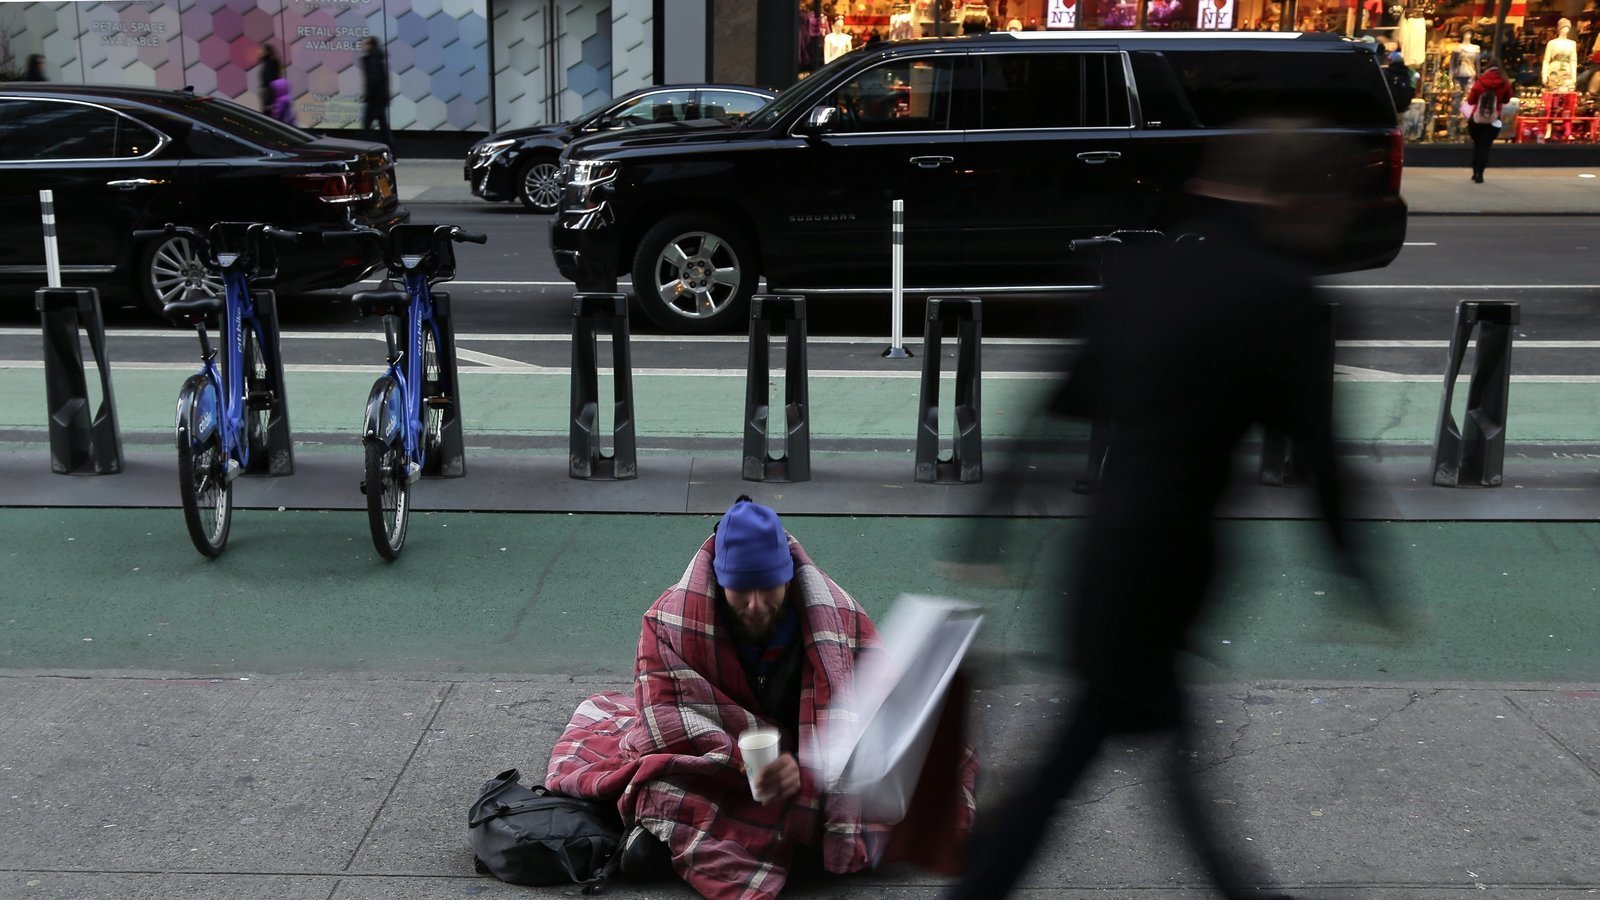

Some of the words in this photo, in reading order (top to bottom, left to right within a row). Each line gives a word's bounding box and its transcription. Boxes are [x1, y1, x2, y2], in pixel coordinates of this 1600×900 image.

[1051, 11, 1076, 23] NY
[1202, 11, 1229, 24] NY
[93, 22, 128, 32] RETAIL
[131, 22, 165, 33] SPACE
[297, 26, 333, 37] RETAIL
[336, 27, 369, 37] SPACE
[102, 36, 159, 47] AVAILABLE
[305, 40, 363, 51] AVAILABLE
